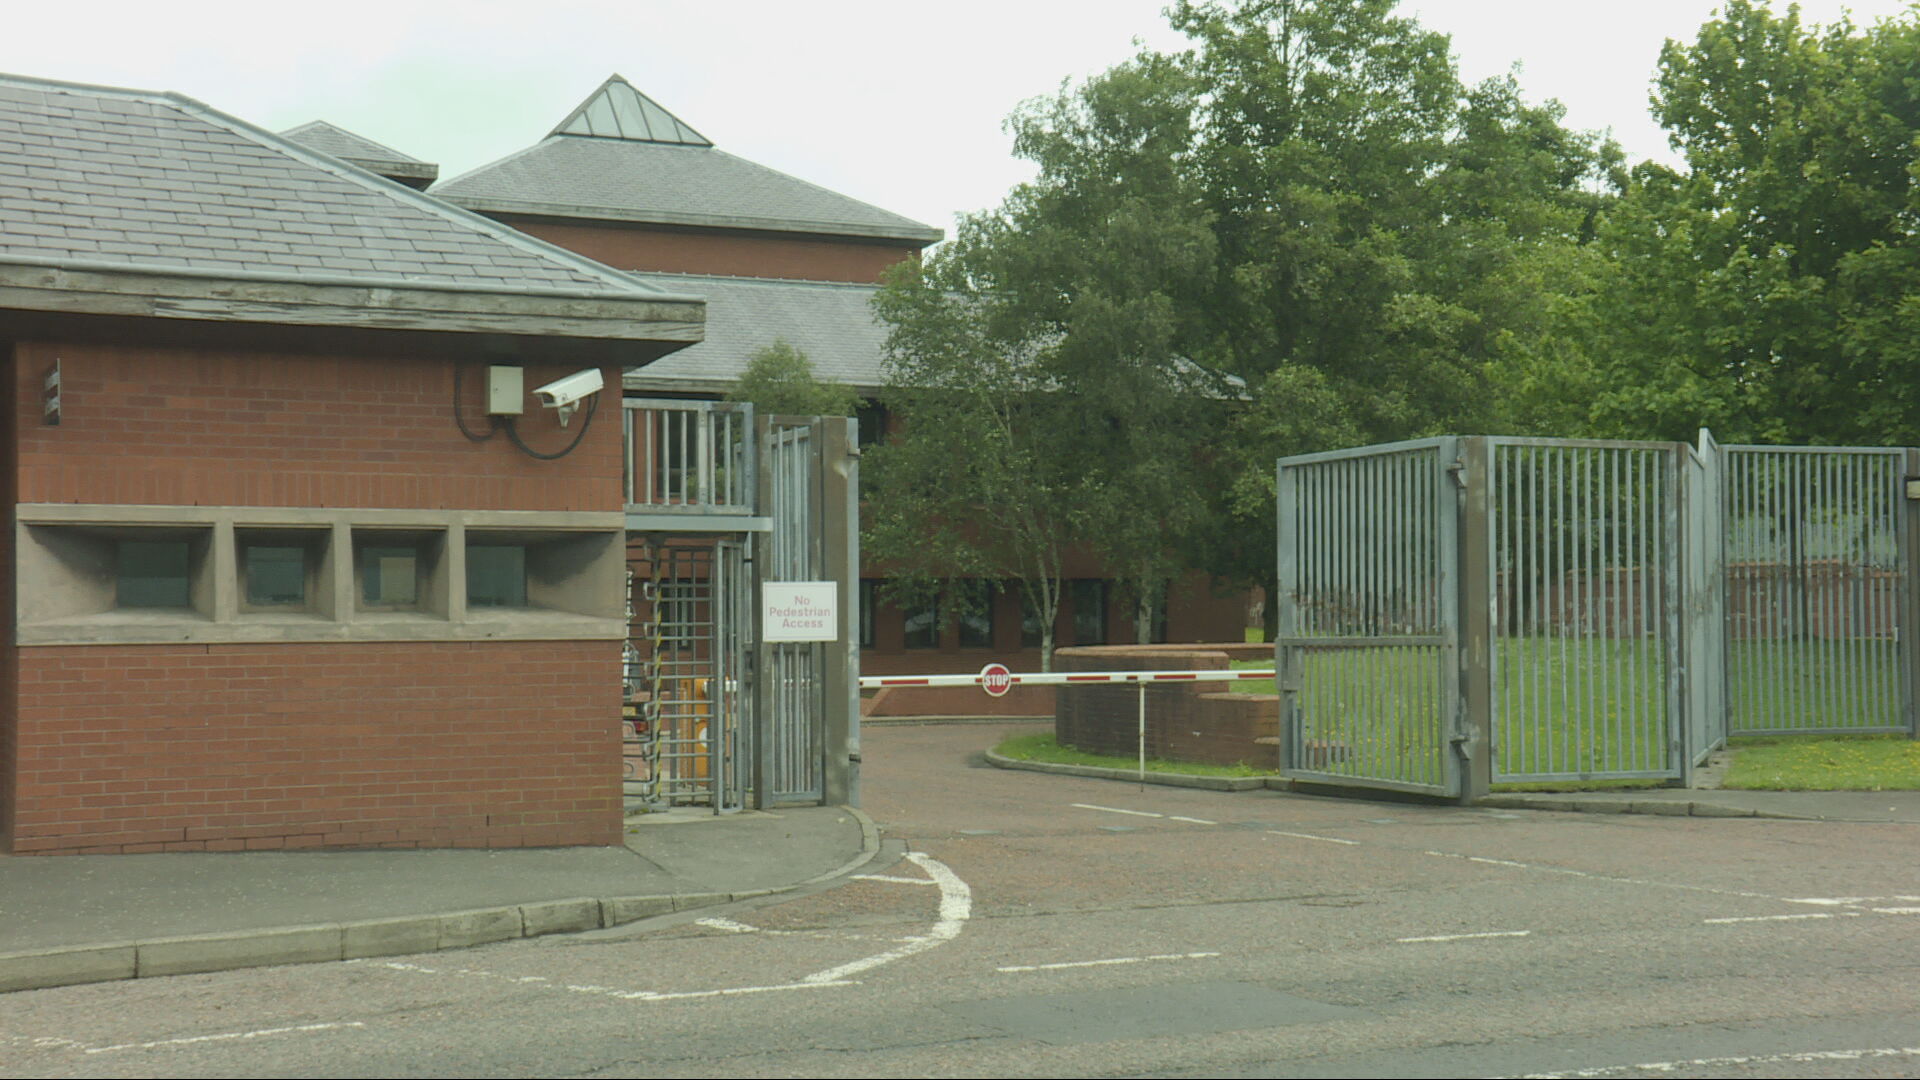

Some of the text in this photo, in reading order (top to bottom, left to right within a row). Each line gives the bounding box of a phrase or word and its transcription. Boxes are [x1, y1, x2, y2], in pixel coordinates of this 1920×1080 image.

[794, 595, 811, 606] No
[769, 606, 831, 617] Pedestrian
[782, 618, 824, 628] Access
[985, 674, 1008, 687] STOP
